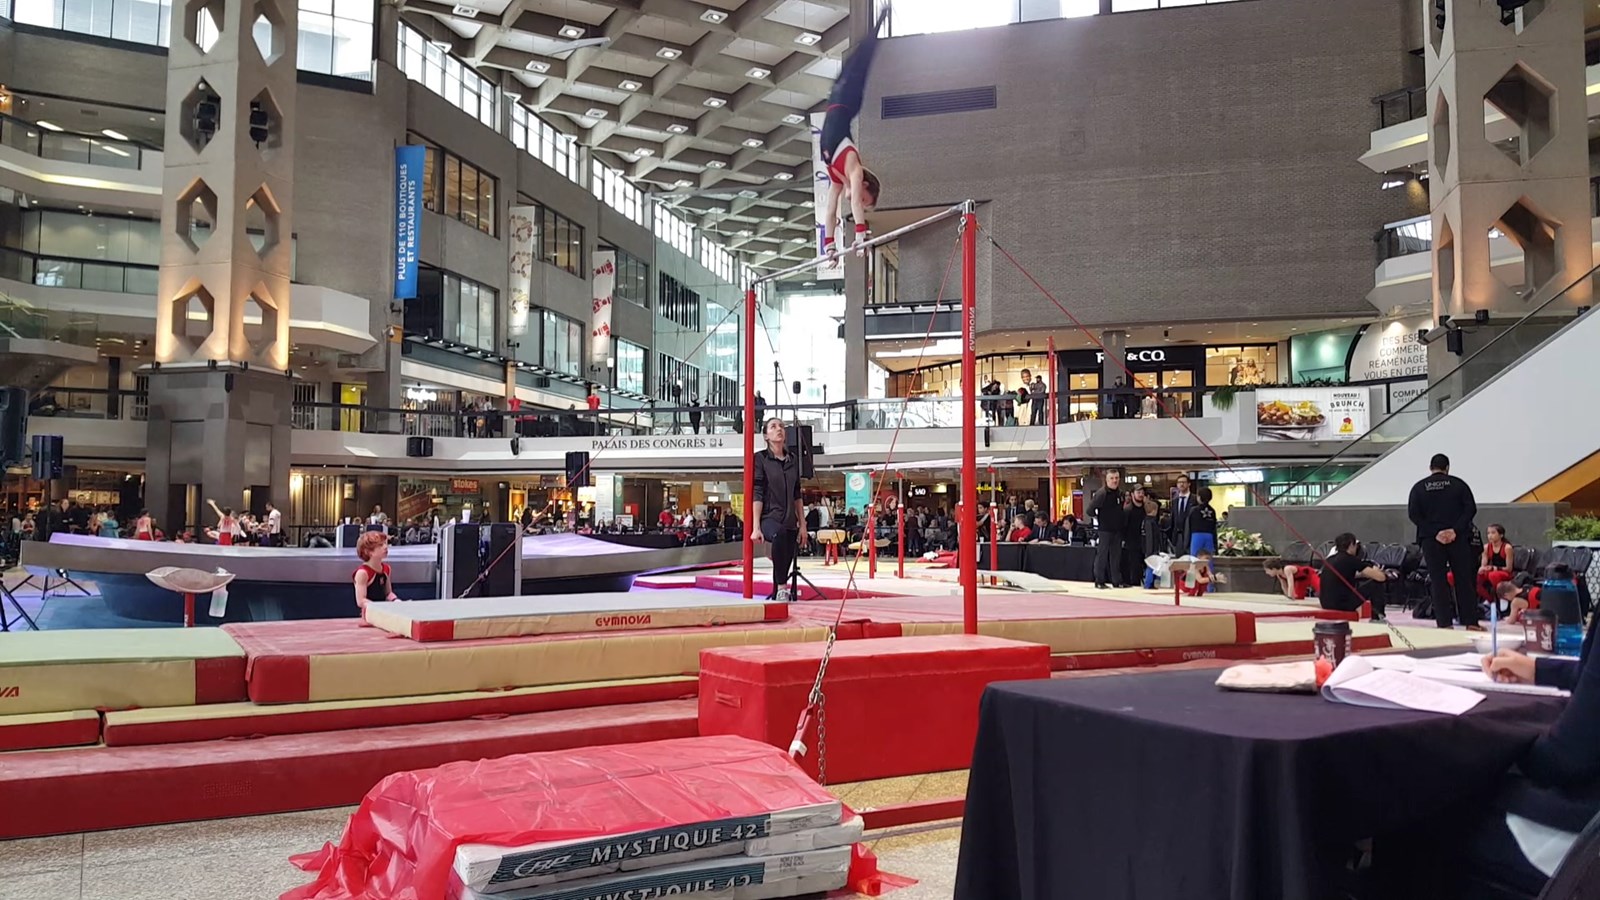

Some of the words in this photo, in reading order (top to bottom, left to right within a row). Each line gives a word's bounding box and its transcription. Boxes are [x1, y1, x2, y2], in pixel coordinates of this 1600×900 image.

[399, 163, 407, 217] BOUTIQUES
[408, 180, 416, 247] RESTAURANTS
[398, 222, 406, 236] 110
[398, 242, 406, 253] DE
[407, 251, 415, 262] ET
[398, 257, 406, 280] PLUS
[1382, 335, 1400, 346] DES
[1402, 333, 1419, 343] ESP
[1379, 344, 1426, 357] COMMERC
[1364, 371, 1388, 380] VOUS
[1390, 368, 1402, 378] EN
[1330, 400, 1364, 408] BRUNCH
[592, 440, 628, 449] PALAIS
[630, 439, 650, 449] DES
[653, 438, 706, 449] CONGRÈS
[595, 615, 651, 627] GYMNOVA
[591, 828, 722, 864] MYSTIQUE
[731, 824, 757, 839] 42
